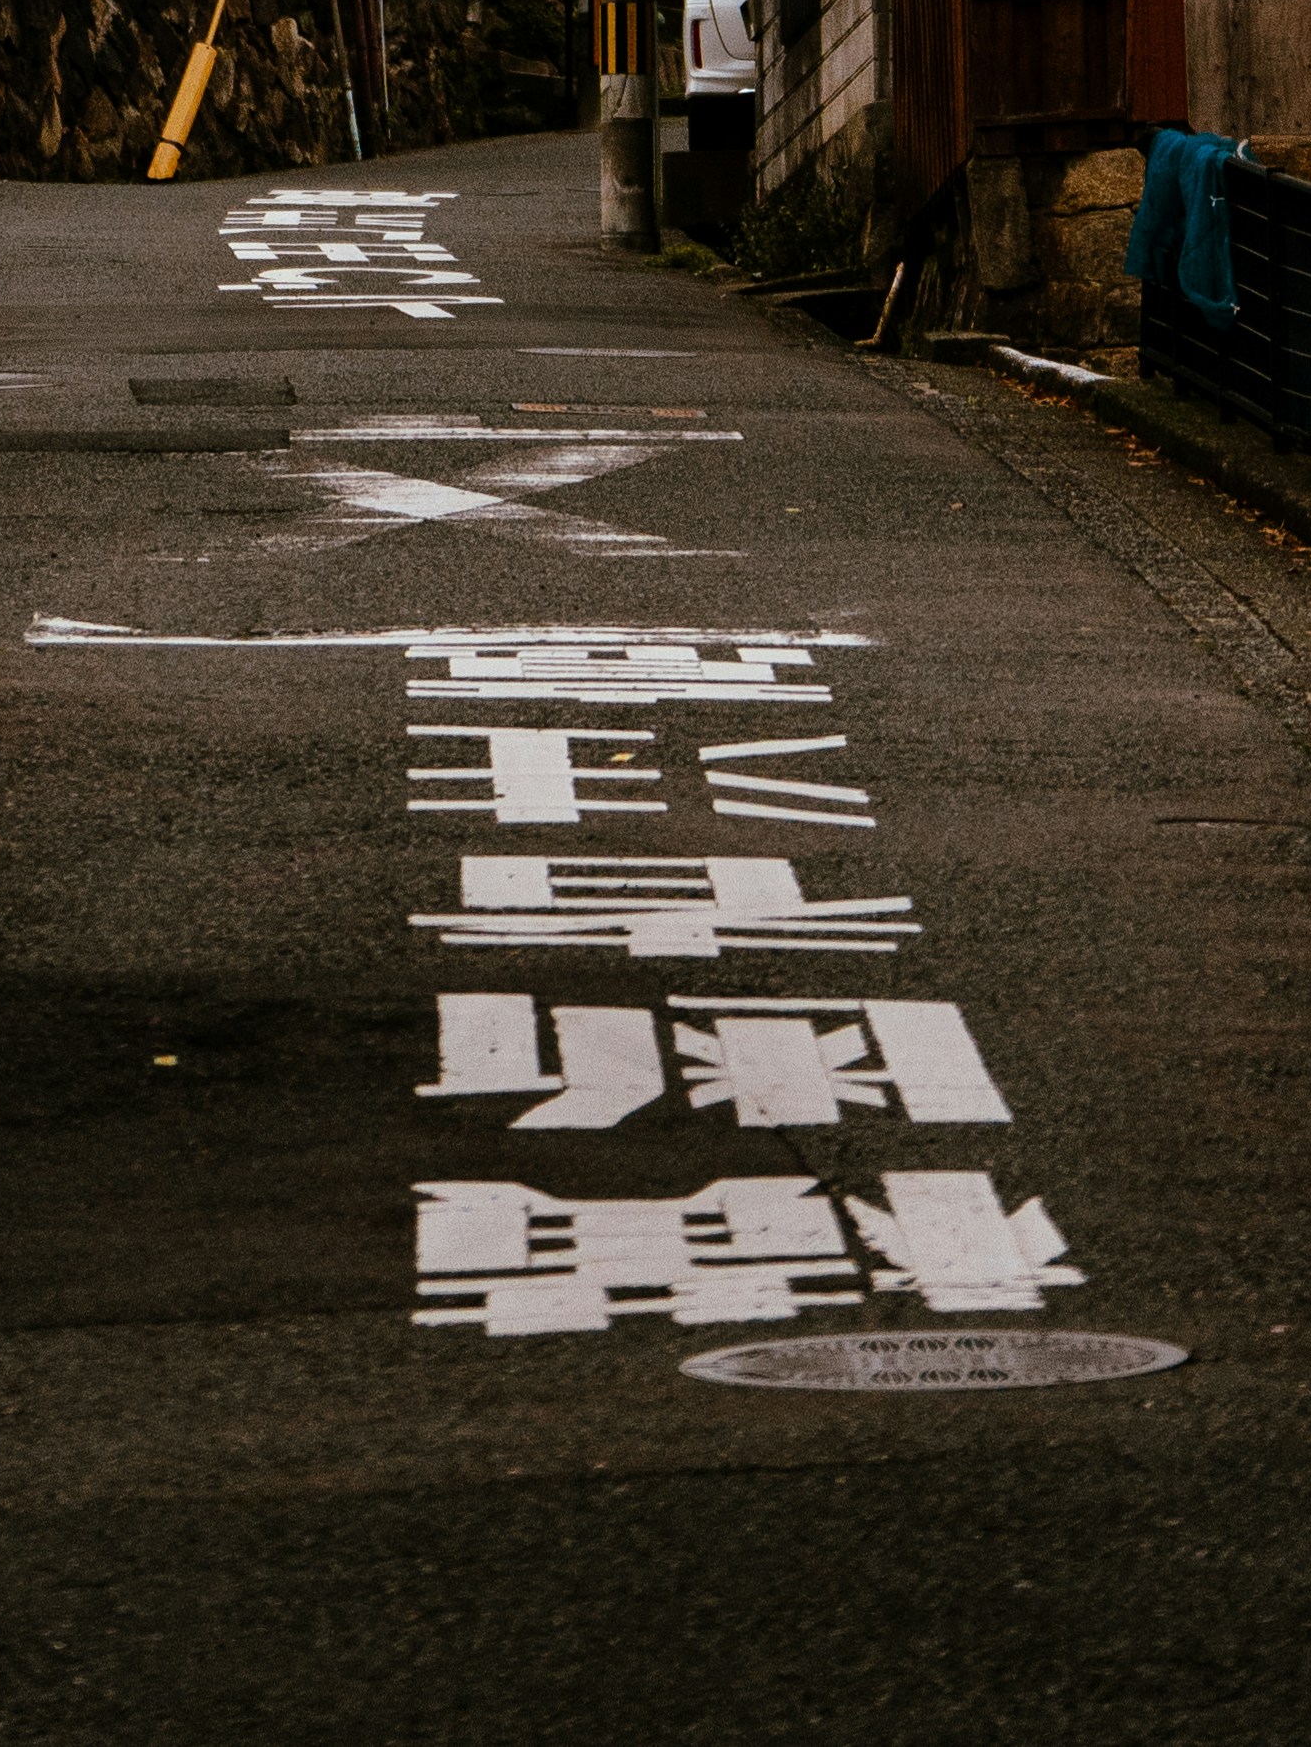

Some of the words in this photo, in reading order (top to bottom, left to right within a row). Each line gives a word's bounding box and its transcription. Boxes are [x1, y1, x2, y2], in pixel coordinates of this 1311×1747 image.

[406, 645, 1085, 1336] 横断者注意
